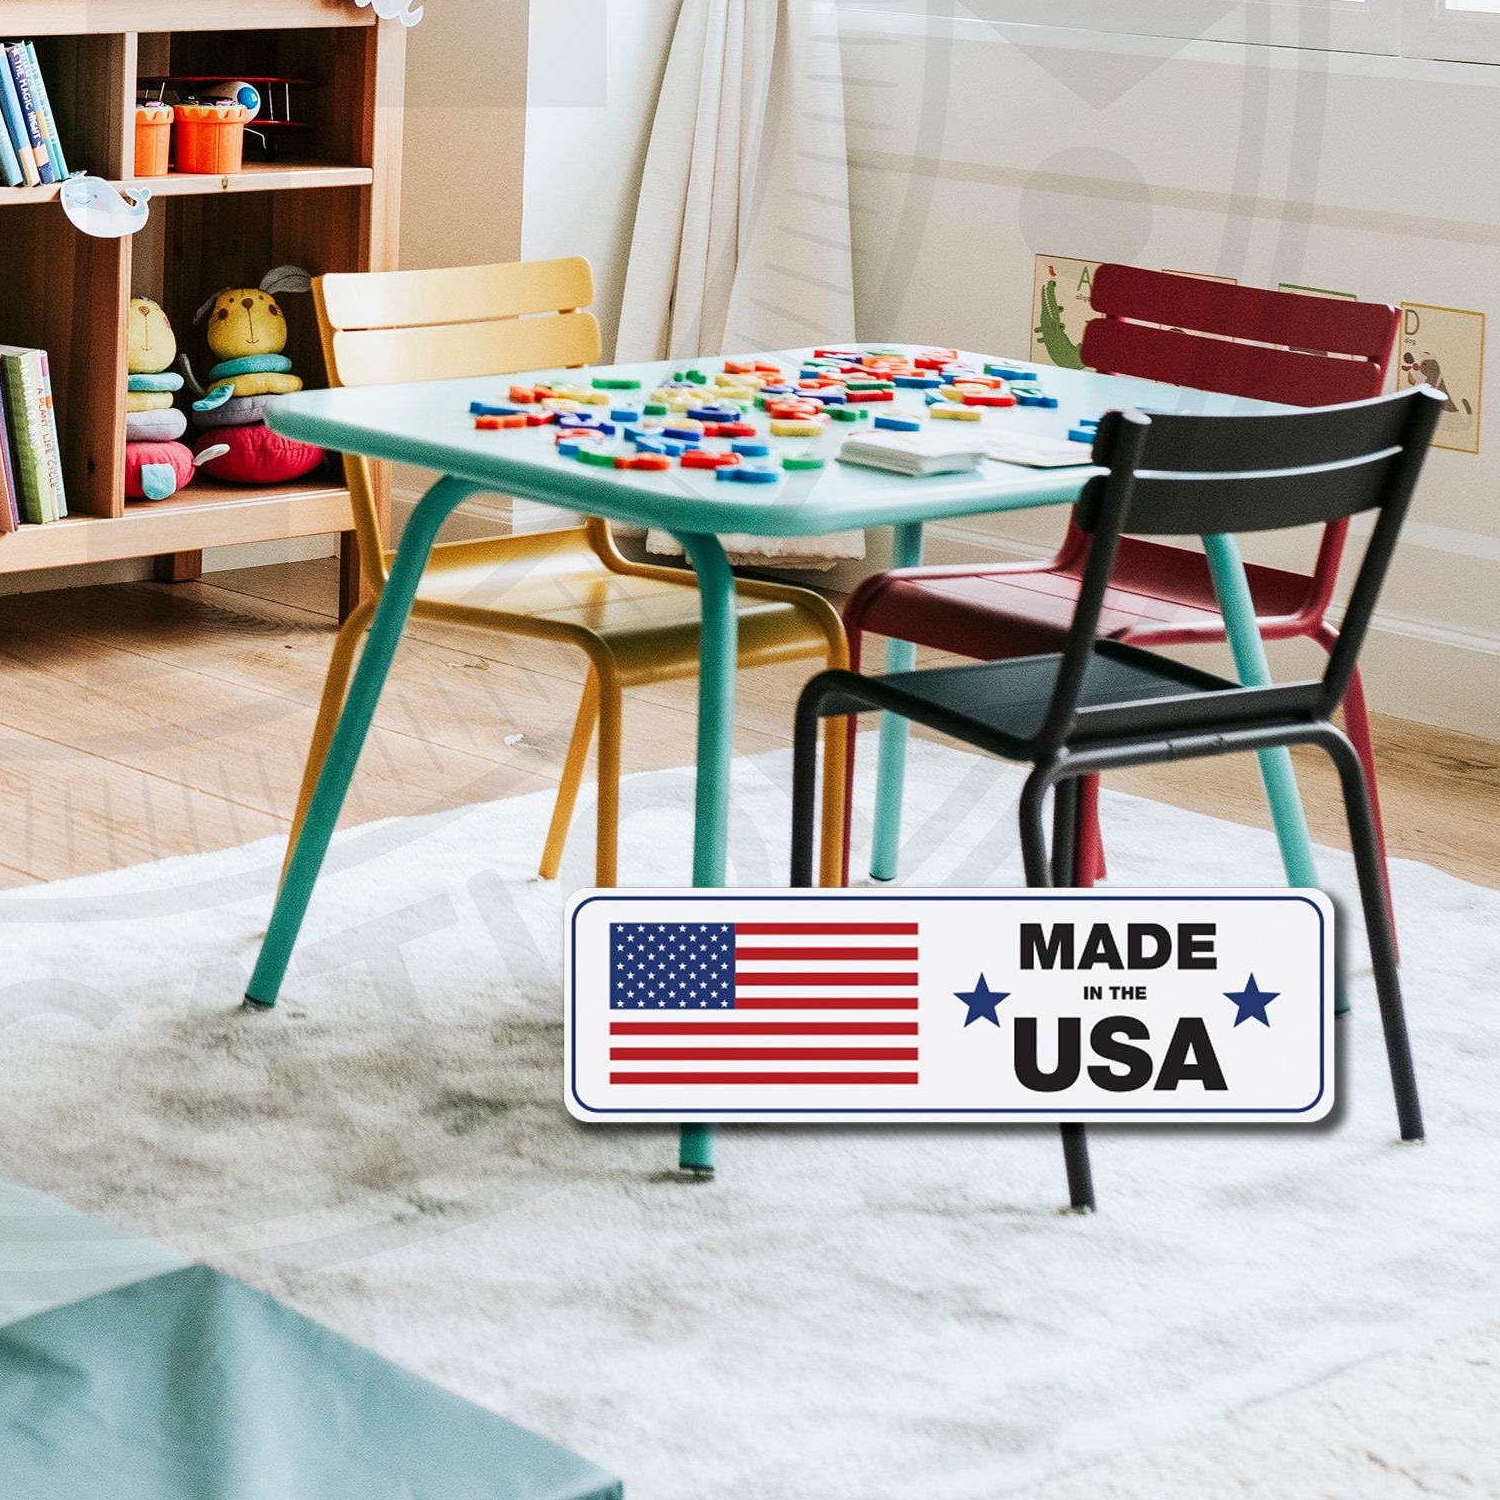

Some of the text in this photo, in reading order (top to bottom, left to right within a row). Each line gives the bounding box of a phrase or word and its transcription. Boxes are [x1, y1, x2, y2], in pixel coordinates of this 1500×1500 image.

[15, 59, 24, 80] THE
[19, 78, 31, 110] MAGIC
[1077, 266, 1092, 291] A
[1405, 309, 1420, 336] D
[36, 387, 56, 490] A PLANT LIFE CYCLE
